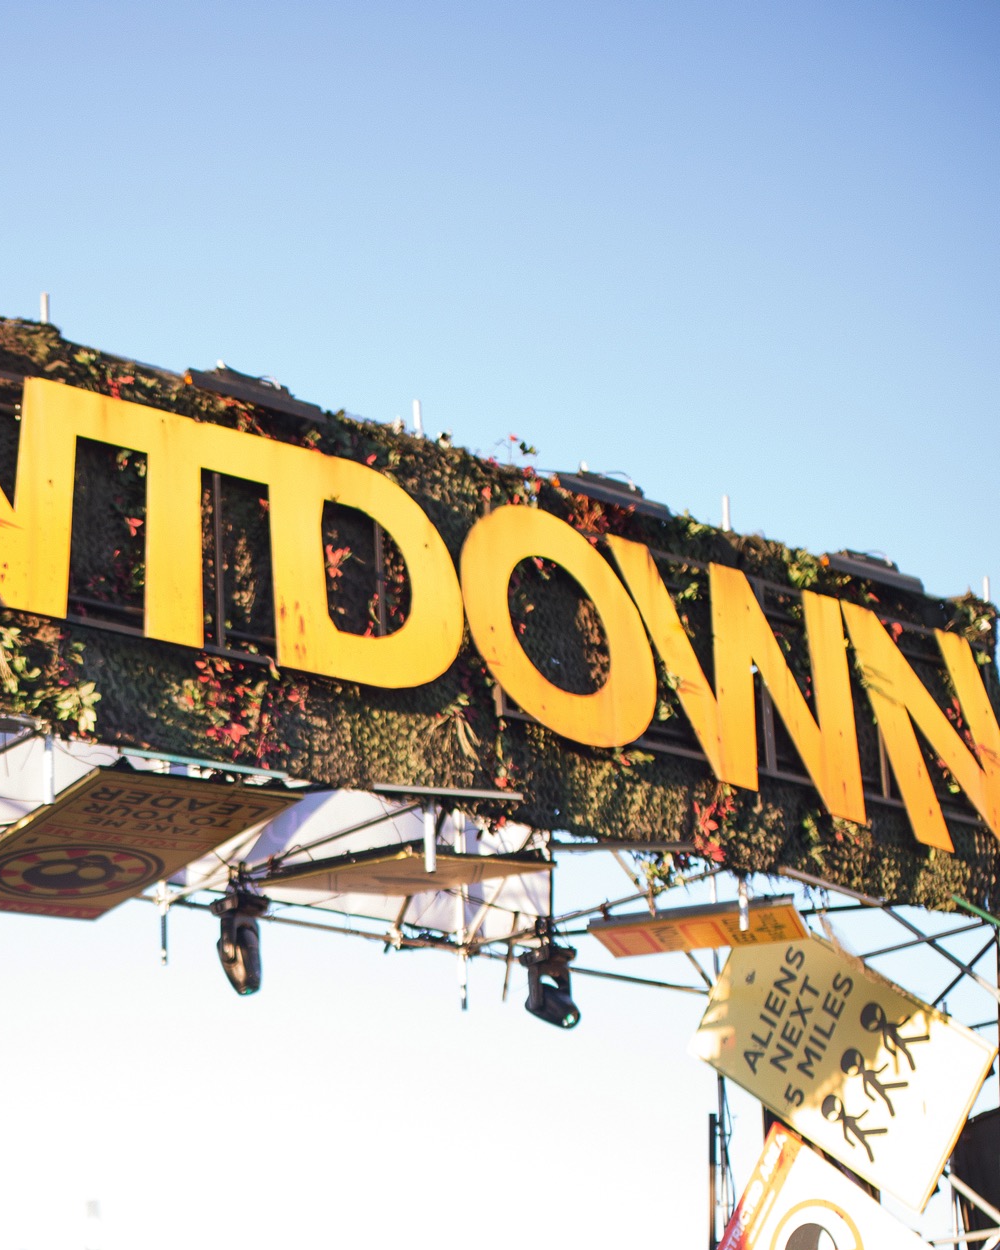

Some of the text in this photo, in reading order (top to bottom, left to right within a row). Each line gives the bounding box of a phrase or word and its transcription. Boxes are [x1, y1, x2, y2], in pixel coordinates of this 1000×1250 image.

[89, 786, 270, 818] LEADER
[82, 803, 235, 829] TO YOUR
[82, 816, 200, 836] TAKE ME
[39, 825, 76, 836] ME
[81, 831, 122, 841] SEE
[132, 838, 177, 848] YOU
[743, 946, 805, 1075] ALIENS
[770, 975, 821, 1073] NEXT
[784, 972, 854, 1107] 5 MILES
